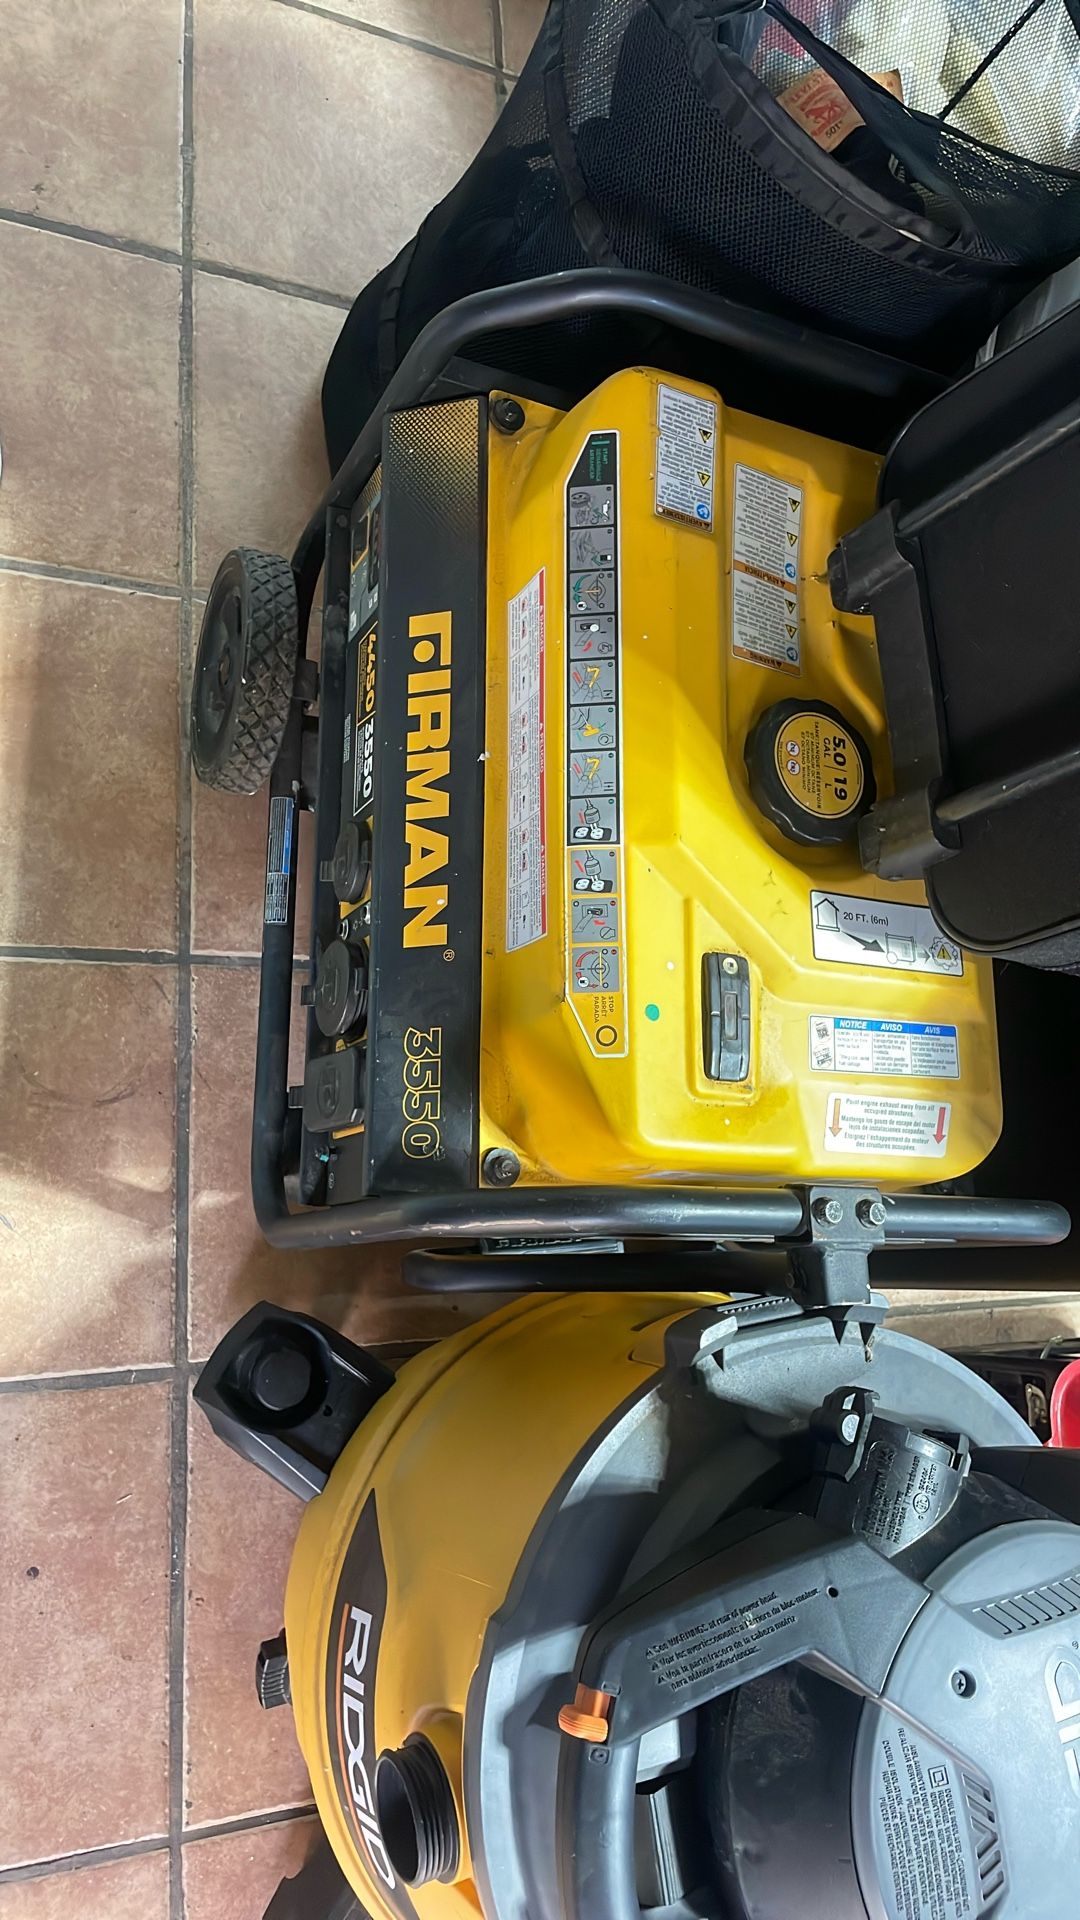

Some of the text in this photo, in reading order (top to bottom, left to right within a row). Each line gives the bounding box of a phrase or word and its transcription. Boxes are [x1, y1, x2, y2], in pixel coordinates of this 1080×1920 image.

[364, 633, 377, 712] 4450
[361, 717, 374, 798] 3550
[832, 735, 847, 800] 5.0 19
[402, 610, 452, 948] FIRMAN
[843, 912, 889, 926] 20 FT. (6m)
[839, 1019, 867, 1029] NOTICE
[880, 1022, 902, 1032] AVISO
[924, 1025, 941, 1034] AVIS
[400, 1026, 442, 1160] 3550
[860, 1099, 878, 1108] engine
[879, 1100, 899, 1108] exhaust
[863, 1107, 886, 1115] occupied
[895, 1120, 912, 1128] escape
[866, 1141, 890, 1149] structures
[885, 1505, 900, 1541] HOUSEHOLD
[892, 1527, 902, 1543] PARA
[652, 1640, 669, 1654] See
[667, 1622, 709, 1647] WARNINGS
[707, 1618, 717, 1629] at
[715, 1611, 733, 1625] rear
[730, 1608, 739, 1618] of
[737, 1599, 761, 1616] power
[658, 1653, 675, 1667] Voir
[674, 1647, 687, 1660] les
[684, 1623, 740, 1655] avertissements
[770, 1604, 781, 1616] du
[664, 1666, 681, 1680] Vea
[679, 1663, 689, 1673] la
[687, 1654, 709, 1671] parte
[706, 1643, 734, 1661] trasera
[732, 1638, 744, 1650] de
[741, 1635, 751, 1645] la
[749, 1623, 776, 1641] cabeza
[669, 1676, 689, 1692] para
[687, 1664, 715, 1683] obtener
[342, 1605, 396, 1889] RIDGID
[881, 1739, 895, 1768] DOUBLE
[897, 1727, 912, 1763] REALIZAR
[906, 1763, 918, 1795] SERVICIO
[909, 1743, 926, 1792] AISLAMIENTO
[889, 1768, 903, 1806] ISOLATION
[912, 1795, 921, 1806] DE
[905, 1797, 916, 1822] PIEZAS
[915, 1806, 927, 1837] AJUSTES
[925, 1818, 933, 1829] NO
[944, 1788, 955, 1816] DOUBLE
[951, 1815, 962, 1853] INSULATED
[884, 1822, 892, 1832] DE
[898, 1810, 910, 1840] AUCUNE
[910, 1823, 918, 1833] DE
[927, 1829, 936, 1840] SE
[929, 1790, 942, 1827] IDENTICAL
[936, 1827, 950, 1877] REPLACEMENT
[943, 1826, 953, 1848] WHEN
[903, 1839, 913, 1857] MISE
[912, 1834, 924, 1869] REPUESTO
[907, 1864, 915, 1873] LA
[909, 1874, 918, 1896] TERRE
